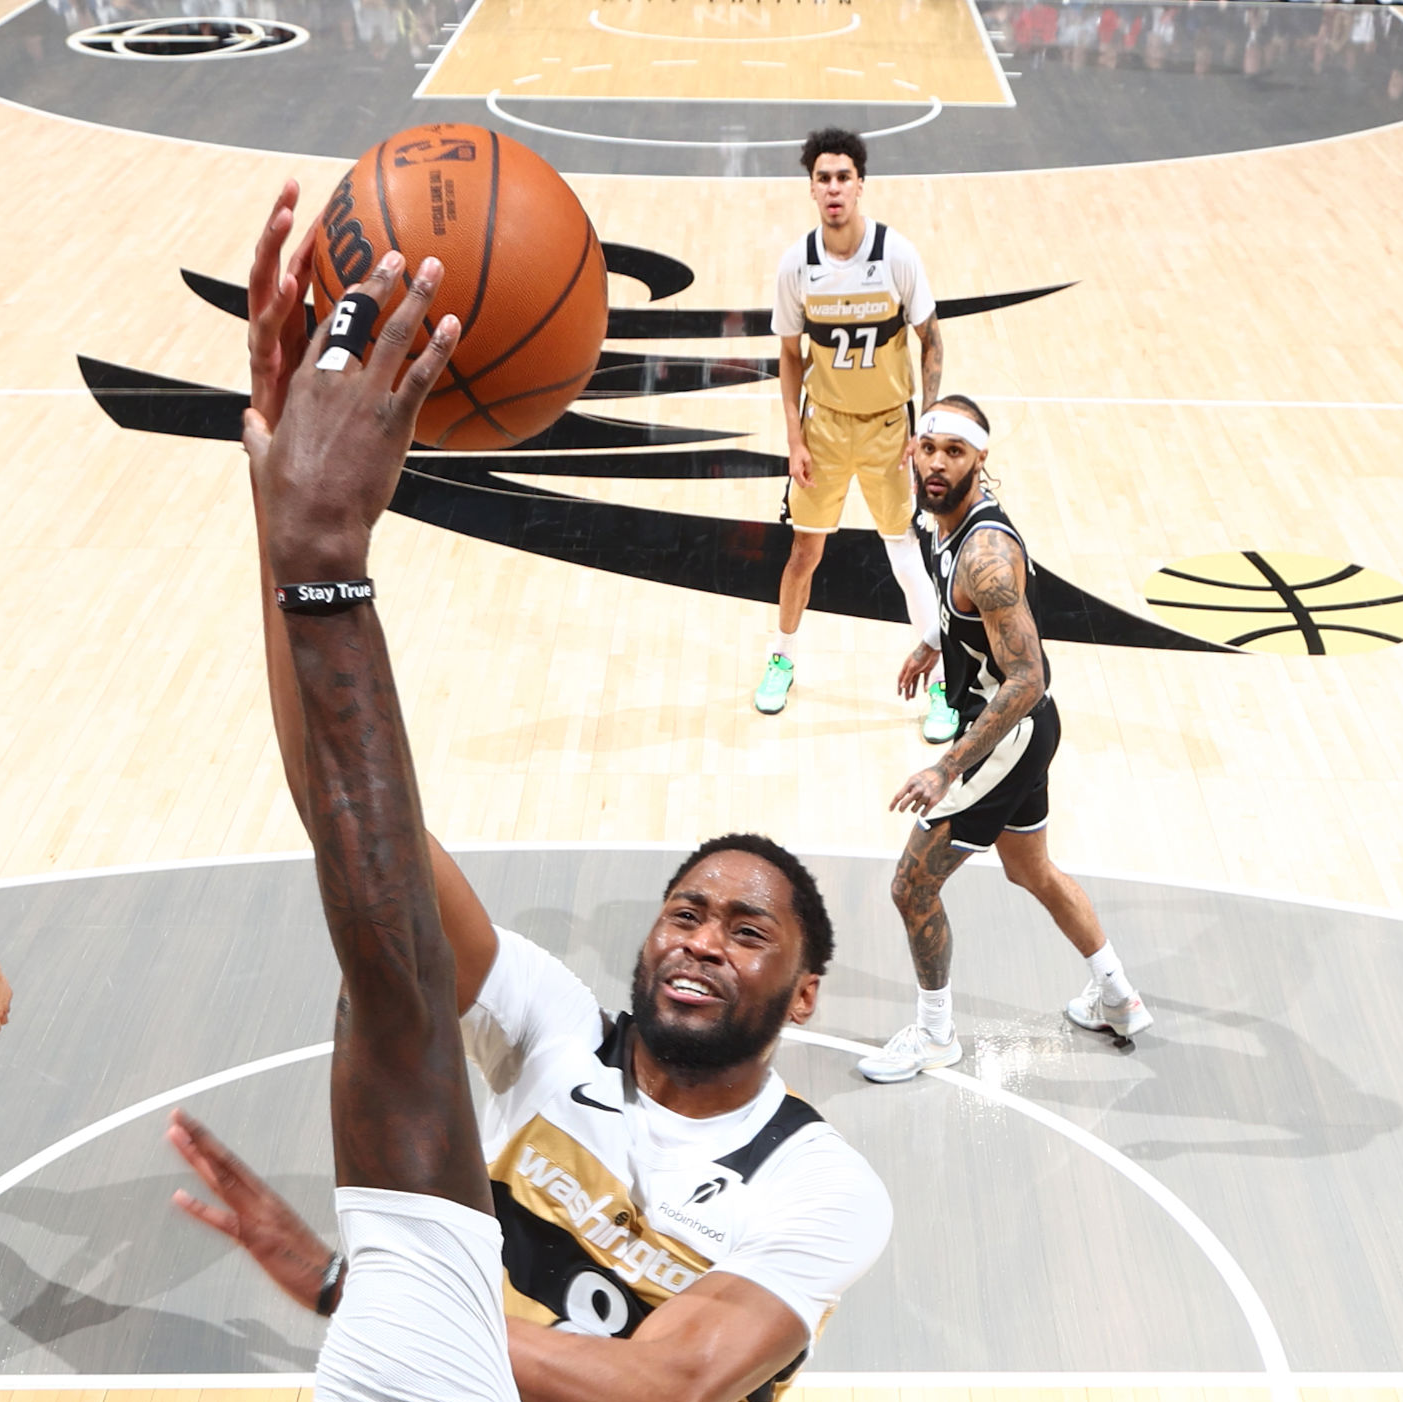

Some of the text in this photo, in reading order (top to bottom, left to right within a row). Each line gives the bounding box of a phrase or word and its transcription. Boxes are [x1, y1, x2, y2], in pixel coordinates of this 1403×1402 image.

[809, 298, 889, 320] washington
[830, 327, 878, 369] 27
[298, 583, 372, 604] Stay True
[516, 1144, 699, 1296] washingto
[658, 1202, 726, 1243] Robinhood
